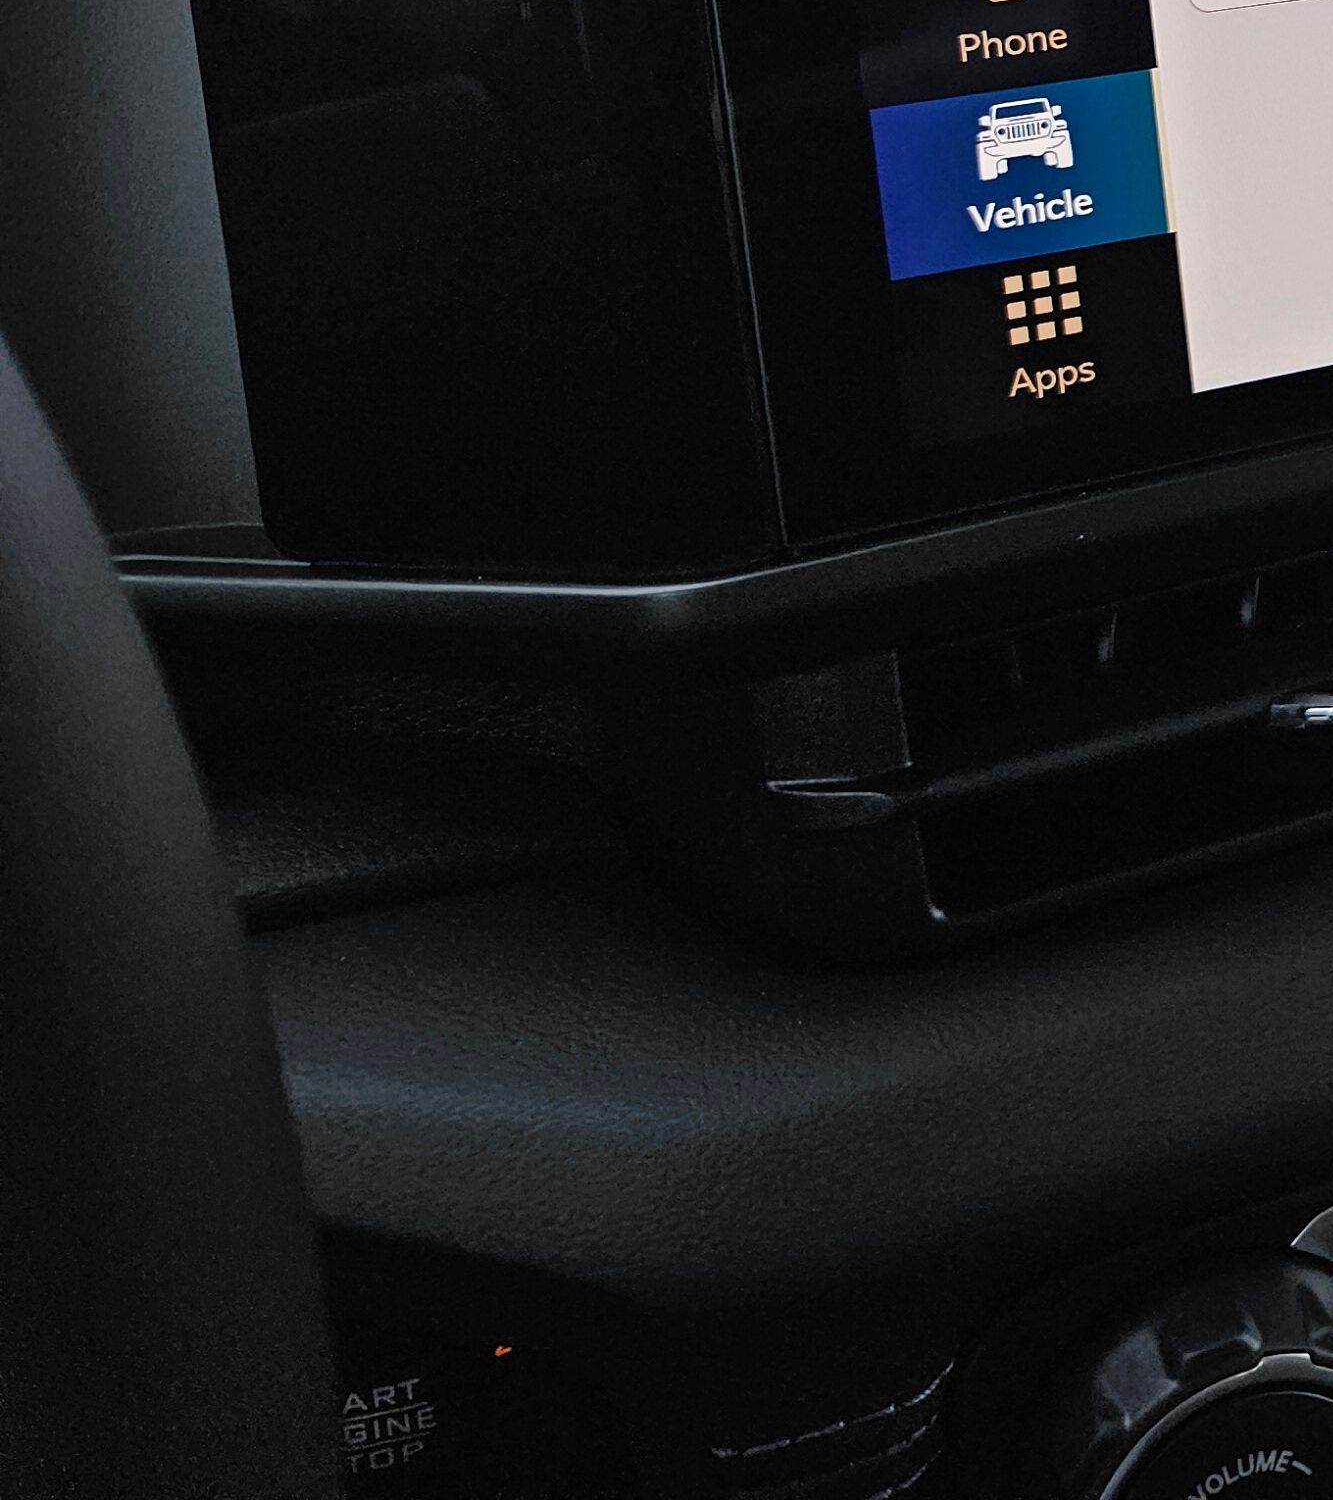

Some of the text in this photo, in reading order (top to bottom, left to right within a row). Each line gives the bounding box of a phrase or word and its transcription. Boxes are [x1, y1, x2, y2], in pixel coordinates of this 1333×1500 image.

[957, 28, 1068, 62] Phone
[966, 188, 1094, 232] Vehicle
[1009, 361, 1096, 399] Apps
[341, 1377, 421, 1415] ART
[342, 1404, 438, 1444] GINE
[346, 1440, 425, 1474] TOP
[1186, 1448, 1295, 1500] VOLUME
